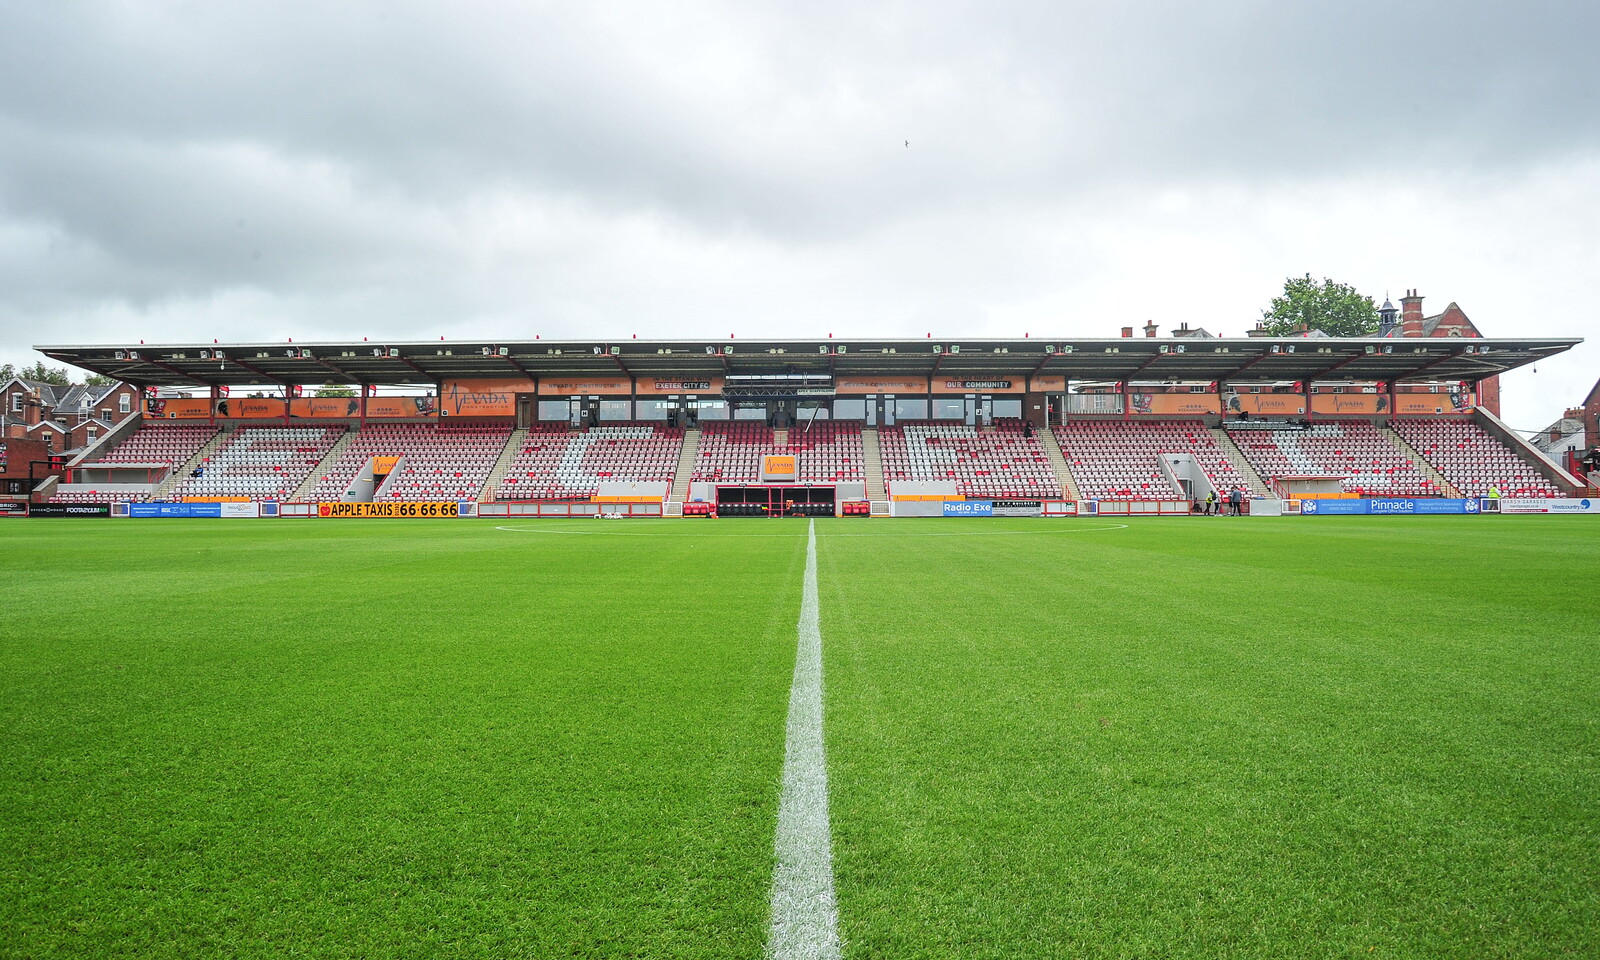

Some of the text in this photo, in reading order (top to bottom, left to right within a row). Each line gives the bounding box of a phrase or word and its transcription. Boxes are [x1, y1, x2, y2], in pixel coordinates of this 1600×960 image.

[331, 504, 393, 516] APPLE TAXIS
[944, 503, 972, 512] Radio
[974, 503, 991, 512] Exe
[1371, 500, 1414, 510] Pinnacle
